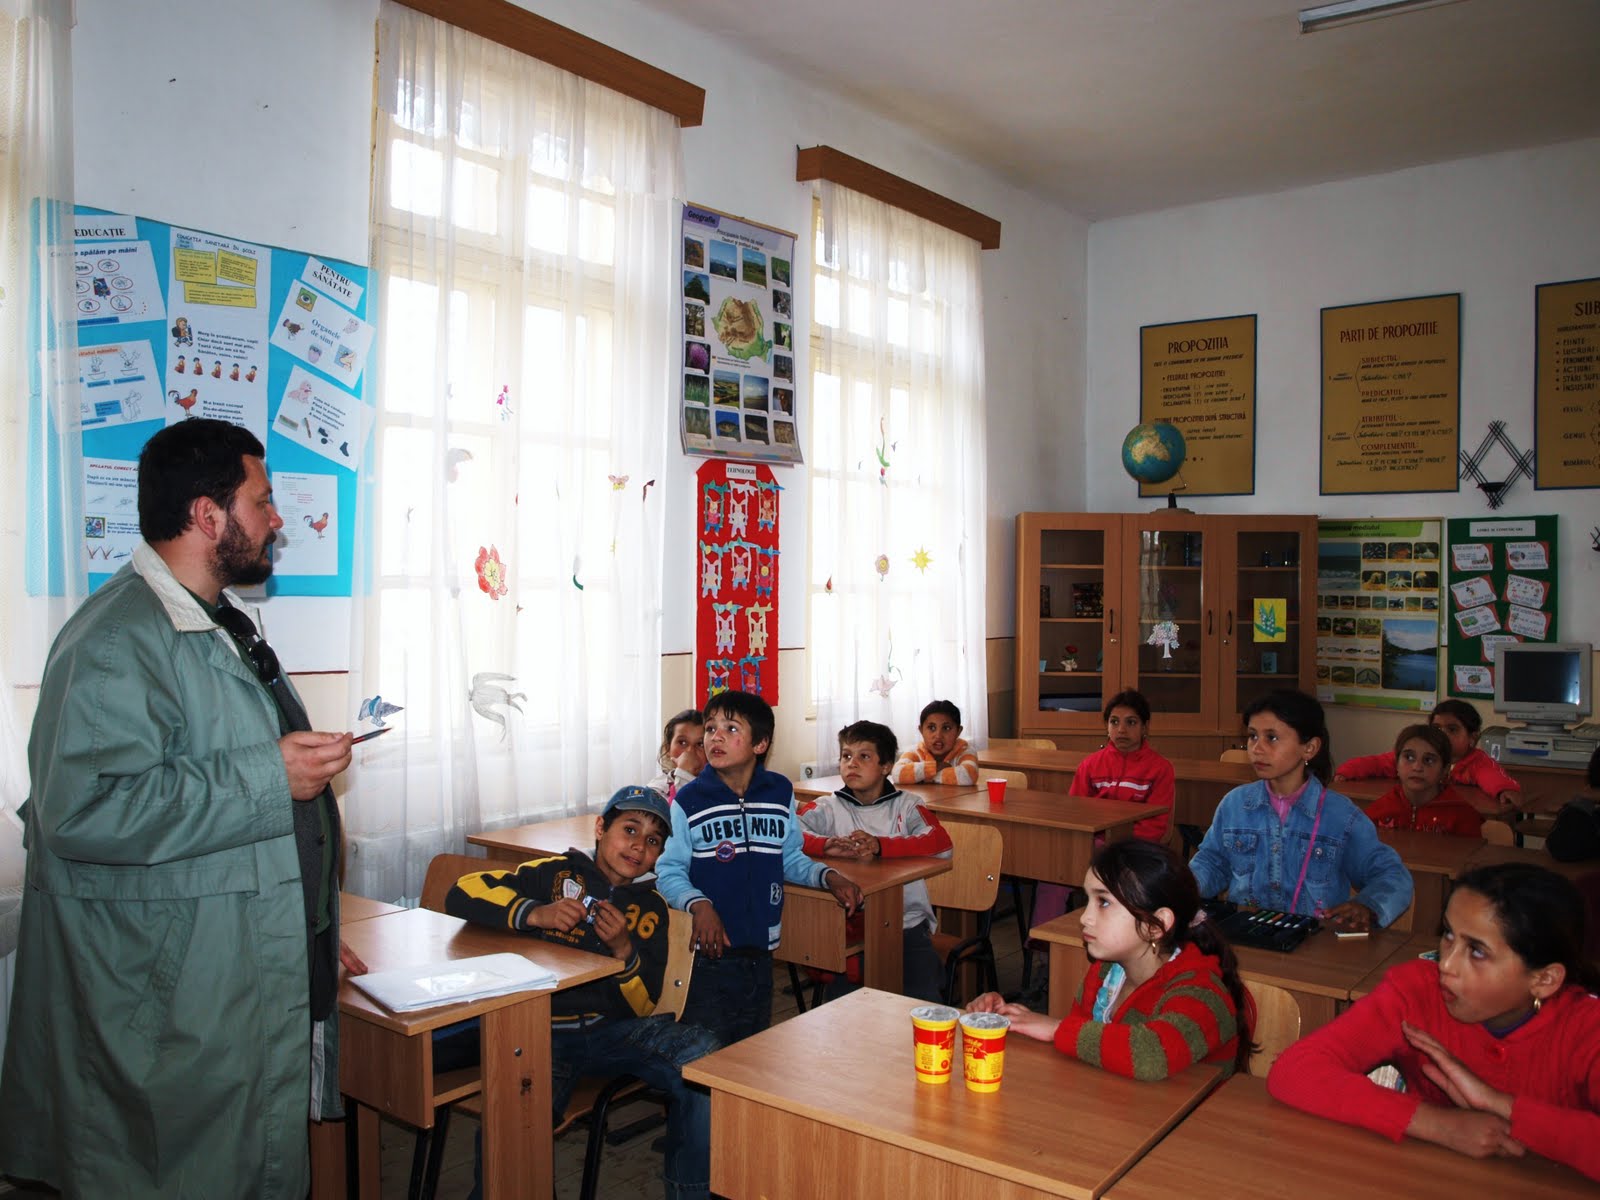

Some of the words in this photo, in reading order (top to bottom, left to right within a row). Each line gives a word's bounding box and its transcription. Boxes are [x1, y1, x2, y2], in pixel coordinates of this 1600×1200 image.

[688, 210, 716, 224] Geografie
[108, 249, 117, 257] pe
[312, 271, 353, 298] SĂNĂTATE
[321, 264, 352, 287] PENTRU
[310, 329, 319, 337] de
[312, 319, 341, 340] Organele
[1368, 327, 1379, 341] DE
[1383, 321, 1438, 339] PROPOZIȚIE
[1168, 337, 1229, 354] PROPOZIȚIA
